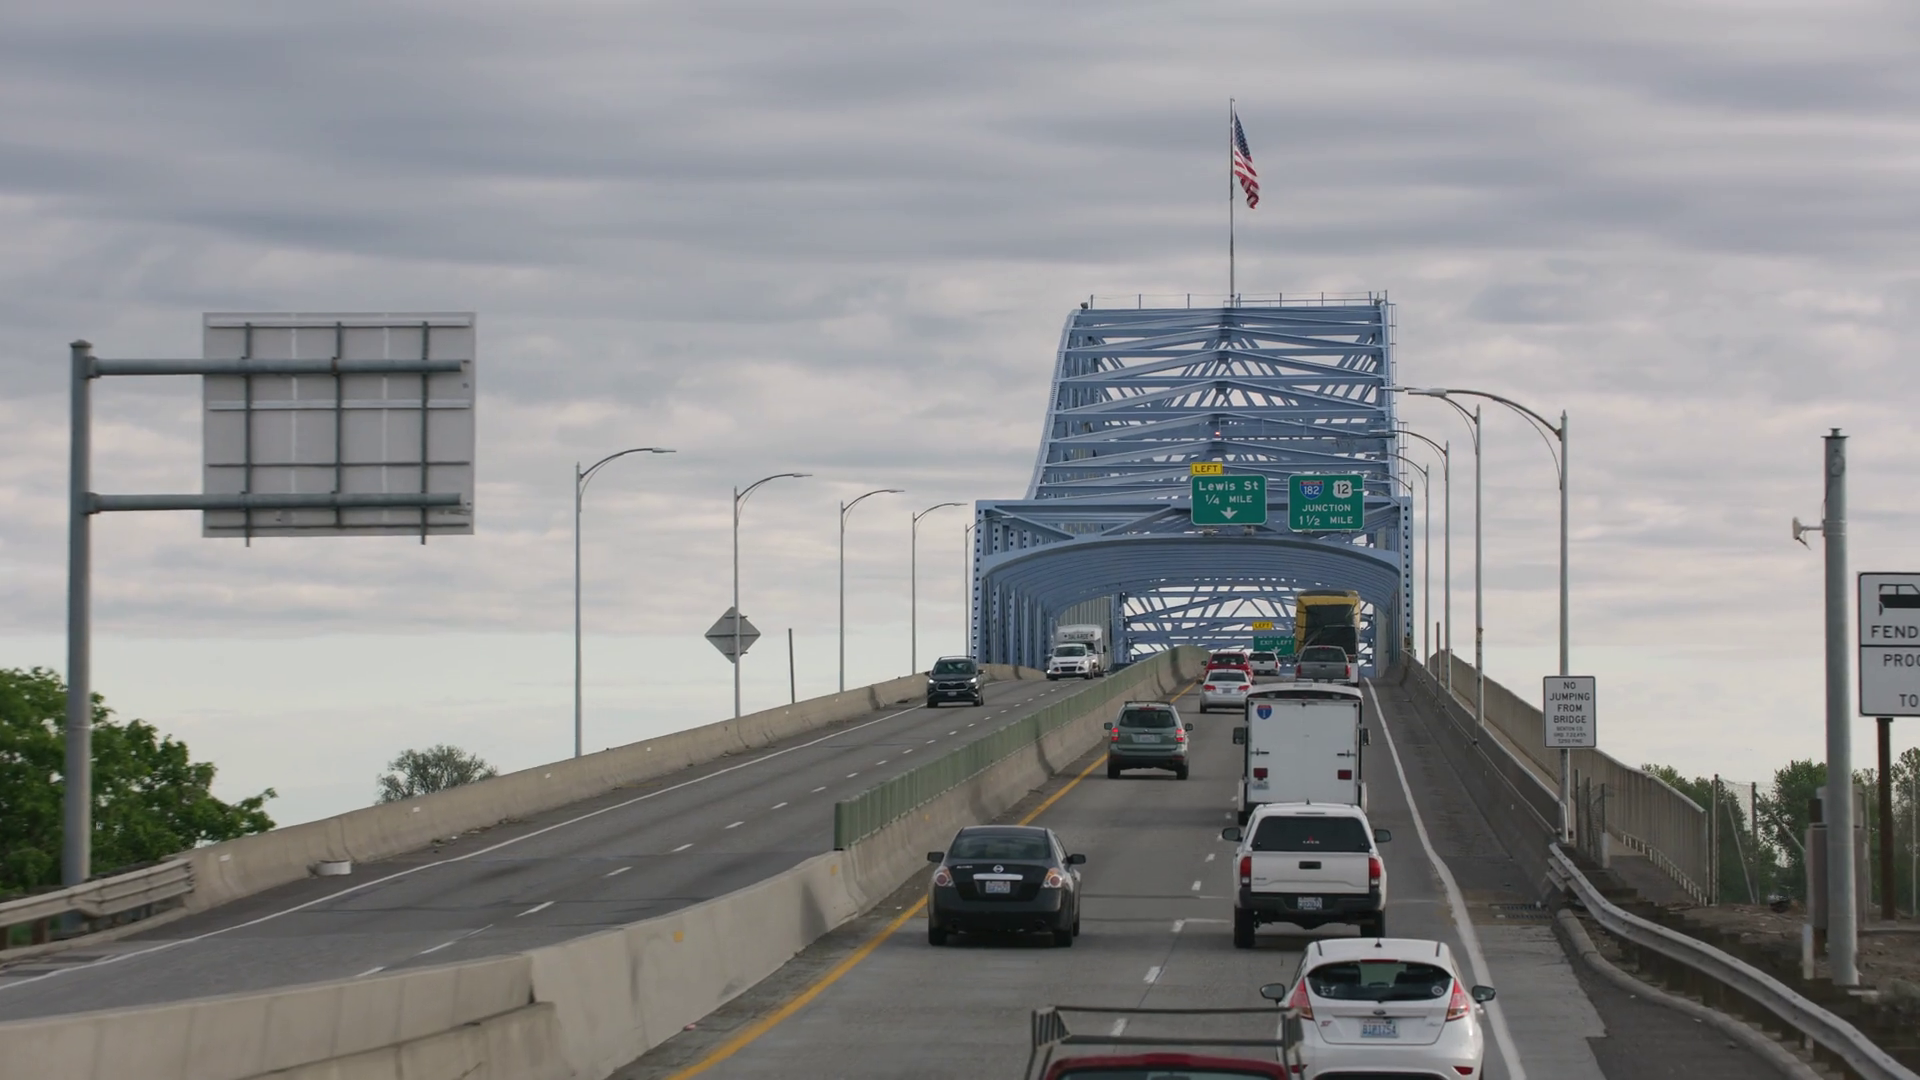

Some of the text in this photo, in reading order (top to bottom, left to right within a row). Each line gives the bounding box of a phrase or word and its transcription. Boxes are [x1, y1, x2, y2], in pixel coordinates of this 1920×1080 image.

[1194, 465, 1218, 473] LEFT
[1198, 481, 1259, 491] Lewis St
[1303, 485, 1320, 495] 182
[1337, 483, 1350, 495] 12
[1229, 495, 1253, 503] MILE
[1302, 504, 1351, 512] JUNCTION
[1329, 516, 1353, 524] MILE
[1563, 681, 1576, 690] NO
[1549, 692, 1590, 701] JUMPING
[1557, 704, 1583, 713] FROM
[1553, 715, 1587, 724] BRIDGE
